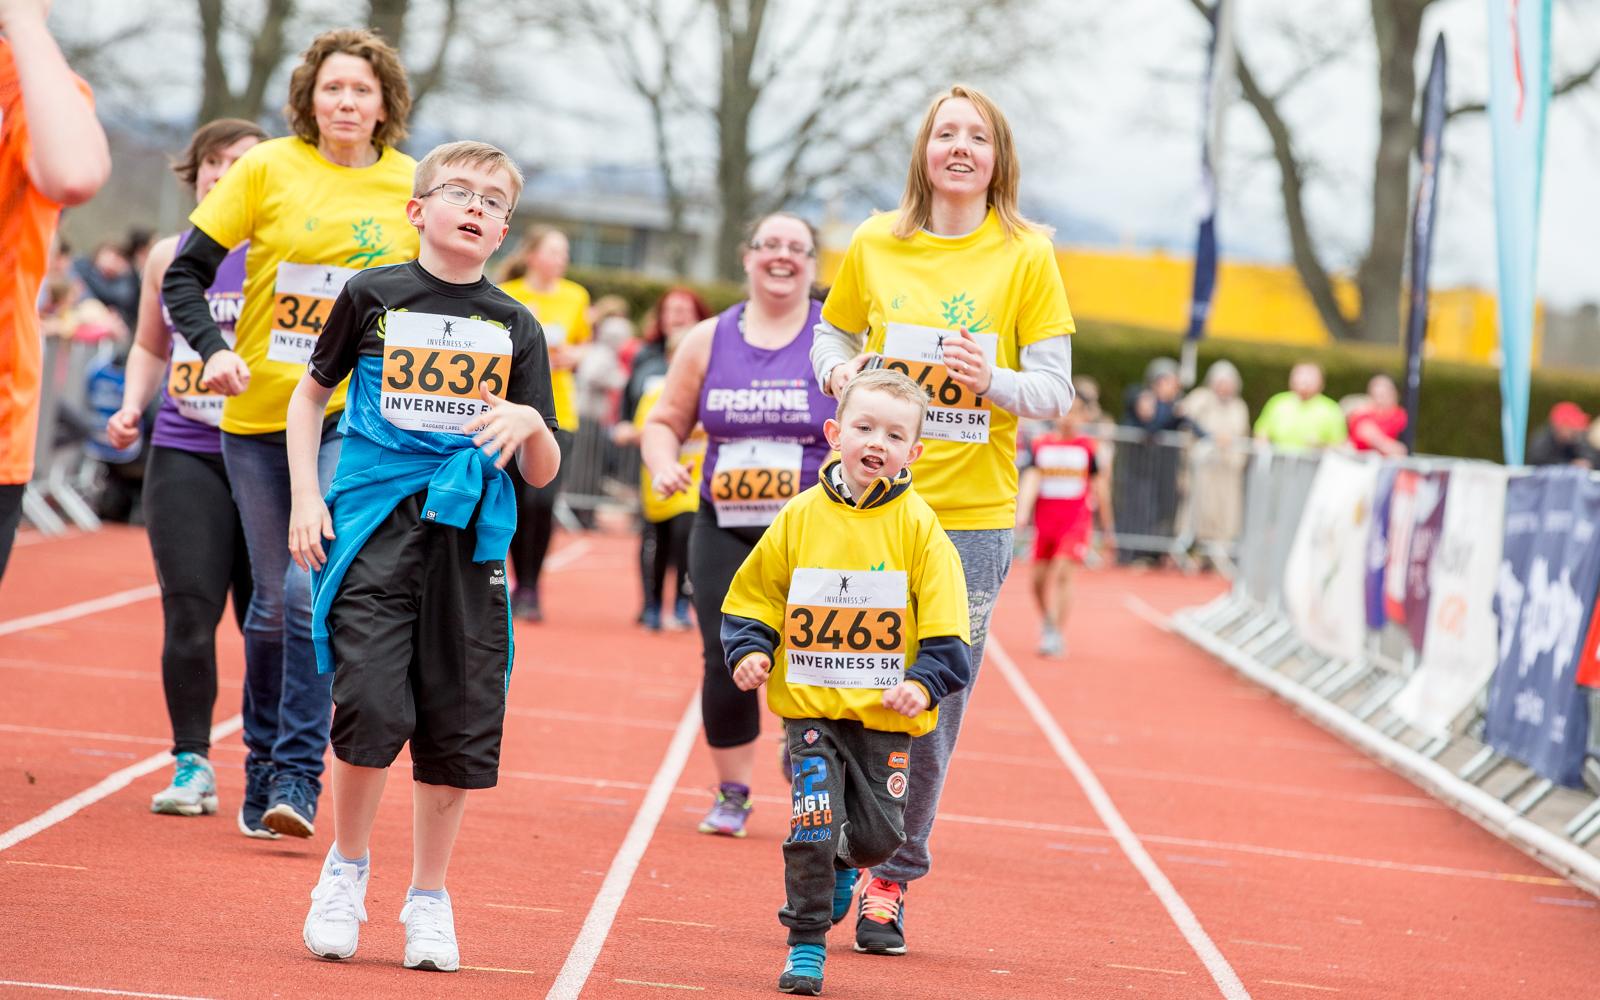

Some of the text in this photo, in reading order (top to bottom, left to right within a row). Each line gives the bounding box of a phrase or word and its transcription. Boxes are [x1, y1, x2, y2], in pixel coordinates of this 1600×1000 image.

[387, 349, 503, 397] 3636
[385, 396, 494, 416] INVERNESS 5
[706, 388, 809, 412] ERSKINE
[725, 411, 811, 423] Proud to care
[968, 413, 986, 425] 5K
[960, 430, 982, 439] 3461
[717, 470, 793, 500] 3628
[824, 596, 858, 604] INVERNESS
[790, 608, 902, 651] 3463
[791, 653, 900, 670] INVERNESS 5K
[874, 676, 898, 686] 3463
[793, 793, 830, 815] HIGH
